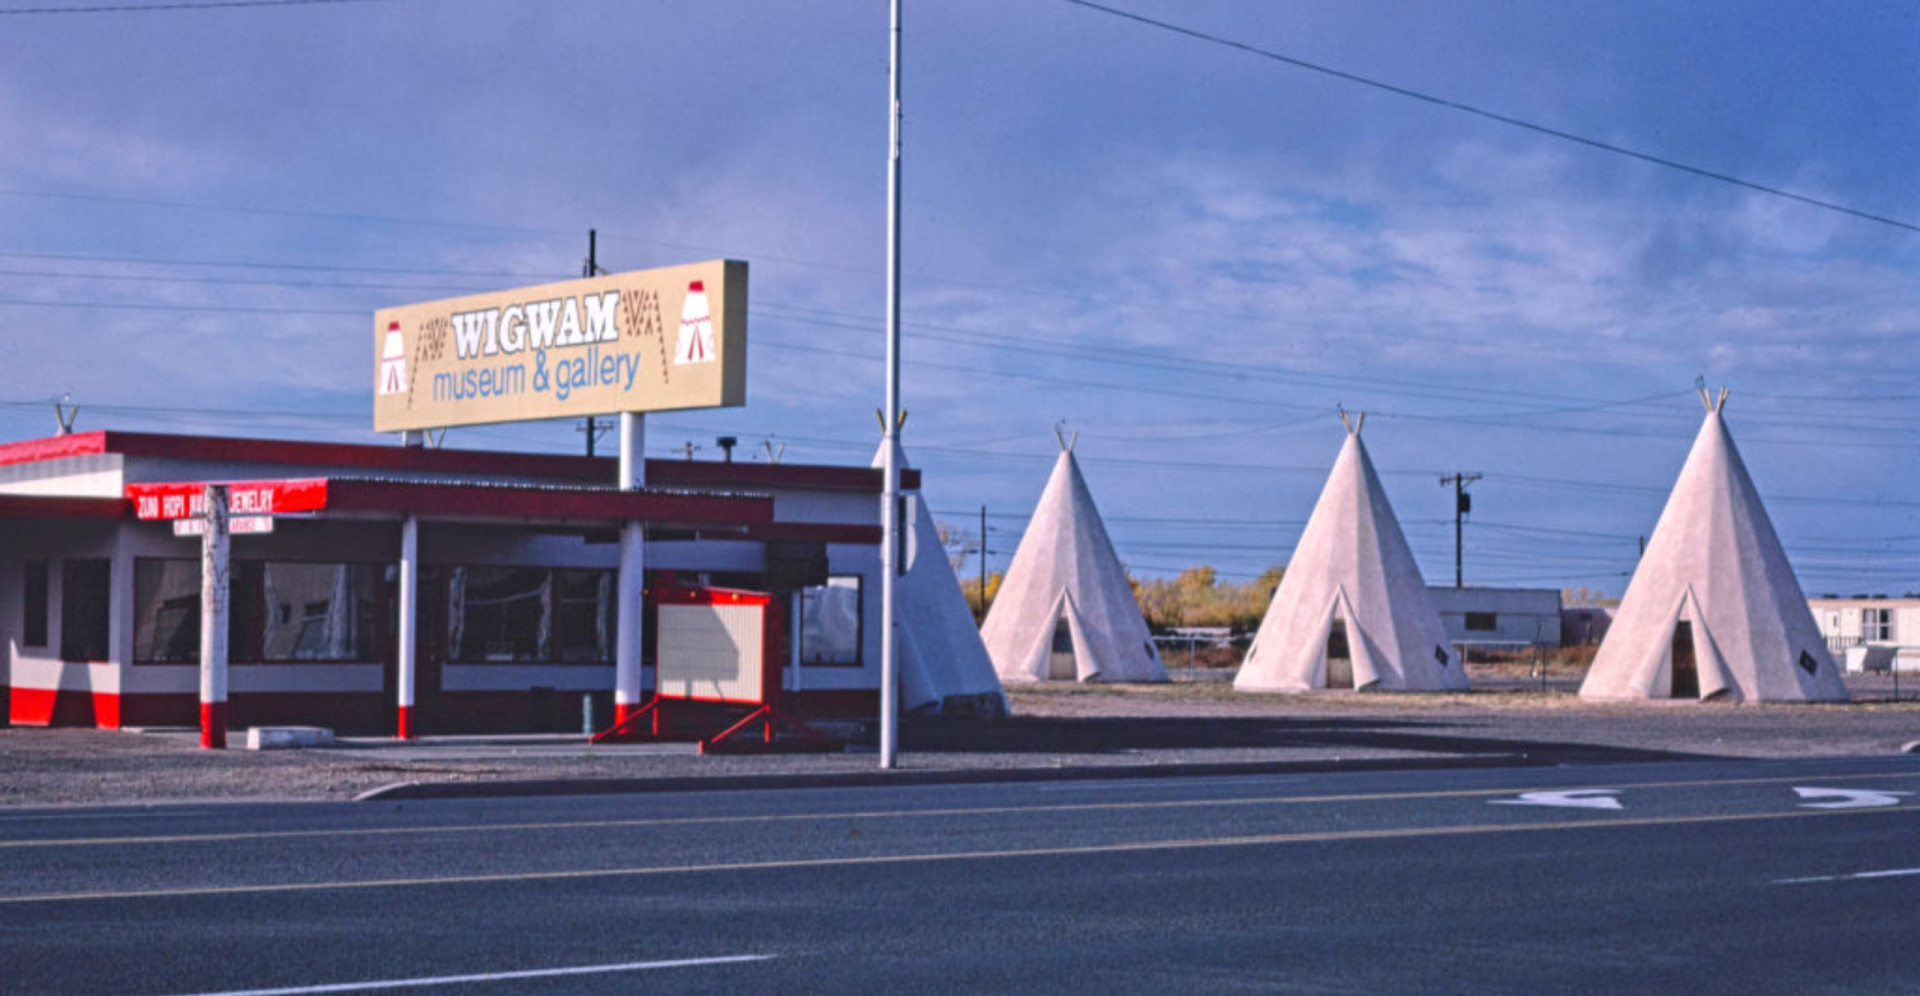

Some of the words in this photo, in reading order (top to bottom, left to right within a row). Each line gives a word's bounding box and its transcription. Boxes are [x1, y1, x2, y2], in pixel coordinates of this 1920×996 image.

[451, 290, 620, 360] WIGWAM
[433, 362, 525, 401] museum
[532, 350, 551, 392] &
[556, 346, 640, 400] gallery
[163, 494, 184, 517] HOPI
[229, 489, 274, 513] JEWELRY
